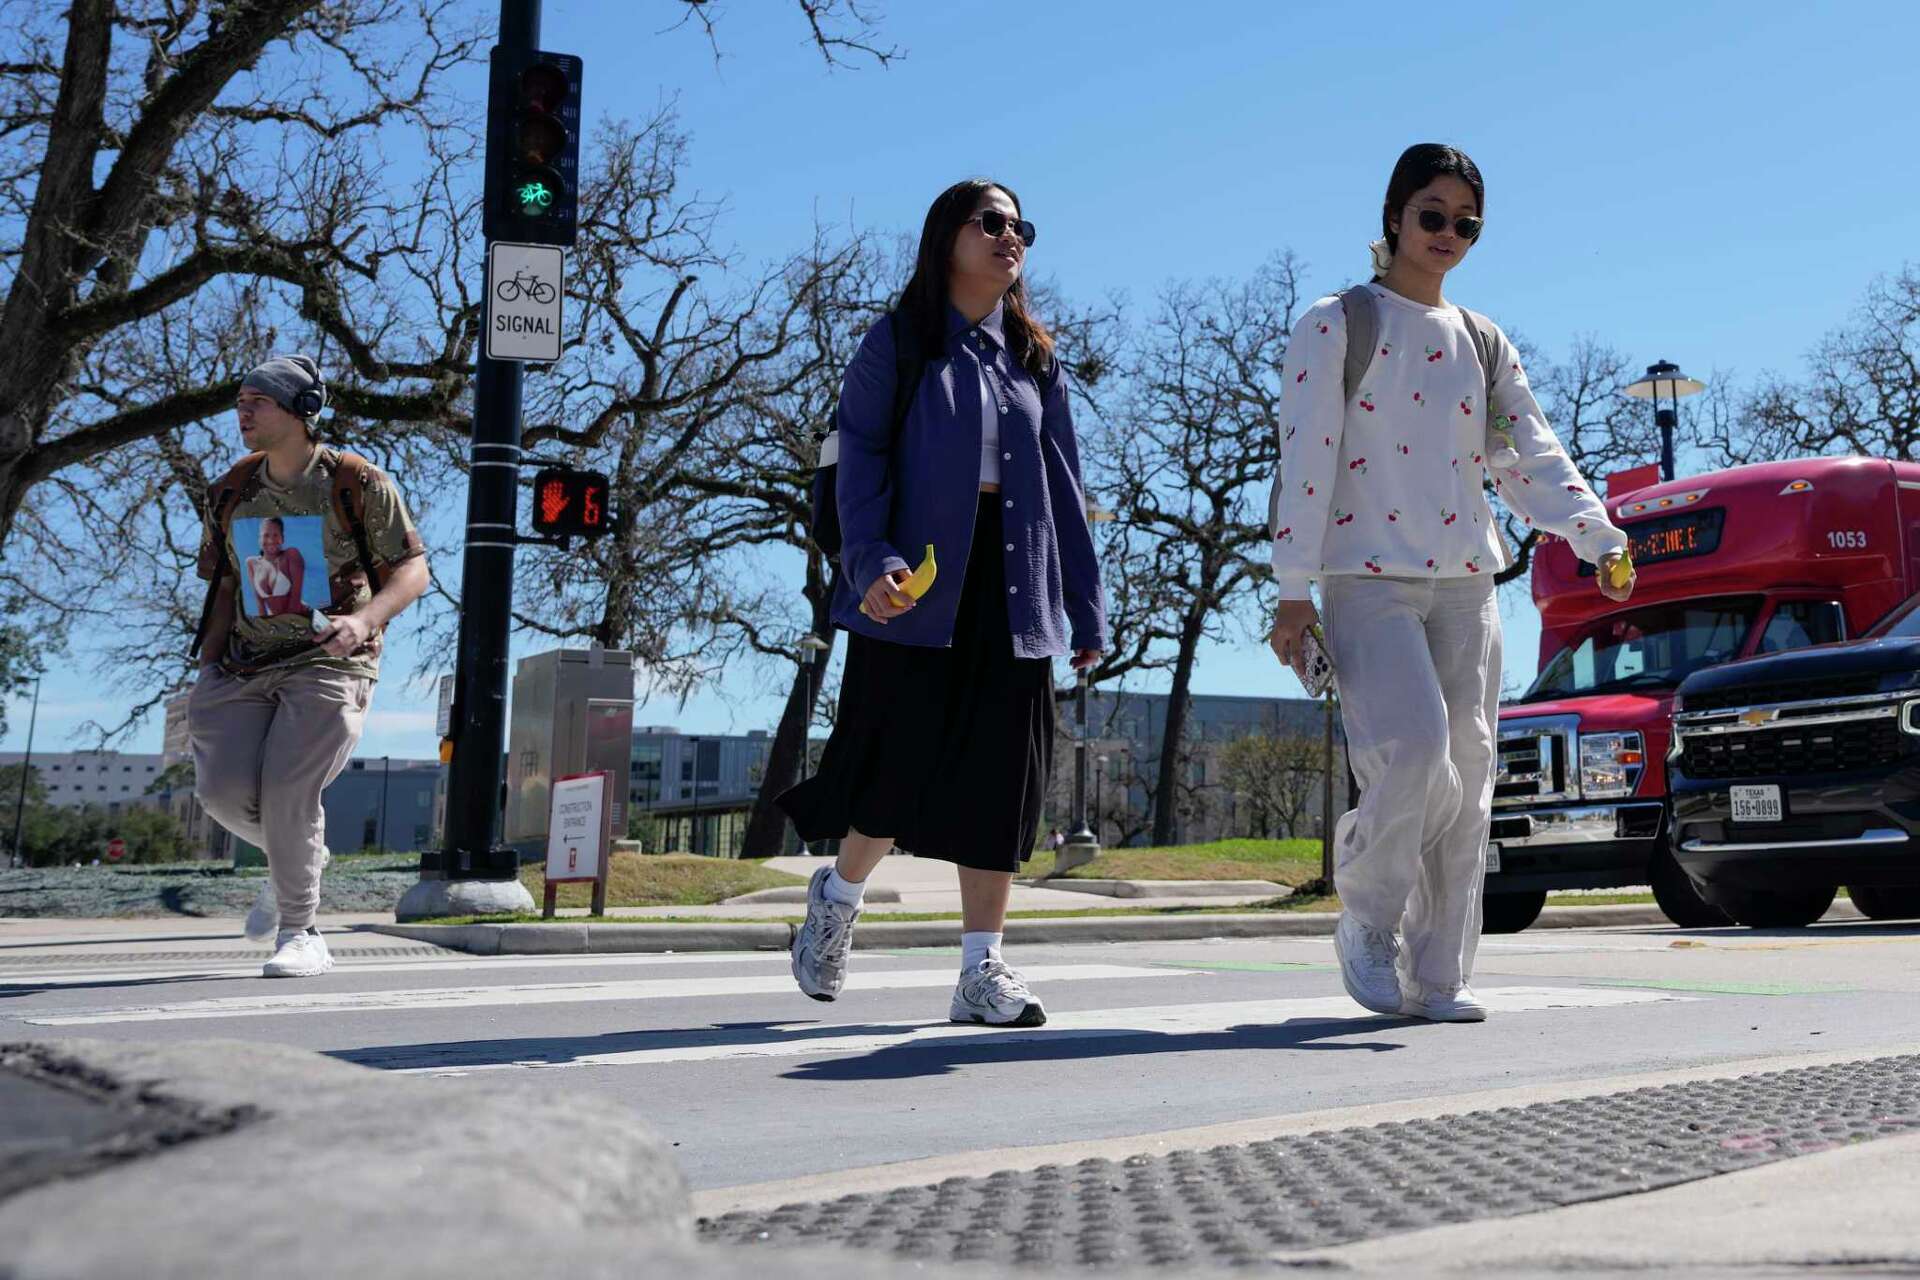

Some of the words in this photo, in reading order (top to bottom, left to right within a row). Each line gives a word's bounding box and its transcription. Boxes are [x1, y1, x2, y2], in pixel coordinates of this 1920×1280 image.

[496, 314, 555, 335] SIGNAL
[583, 486, 600, 527] 6
[1826, 531, 1867, 548] 1053
[1745, 788, 1765, 797] TEXAS
